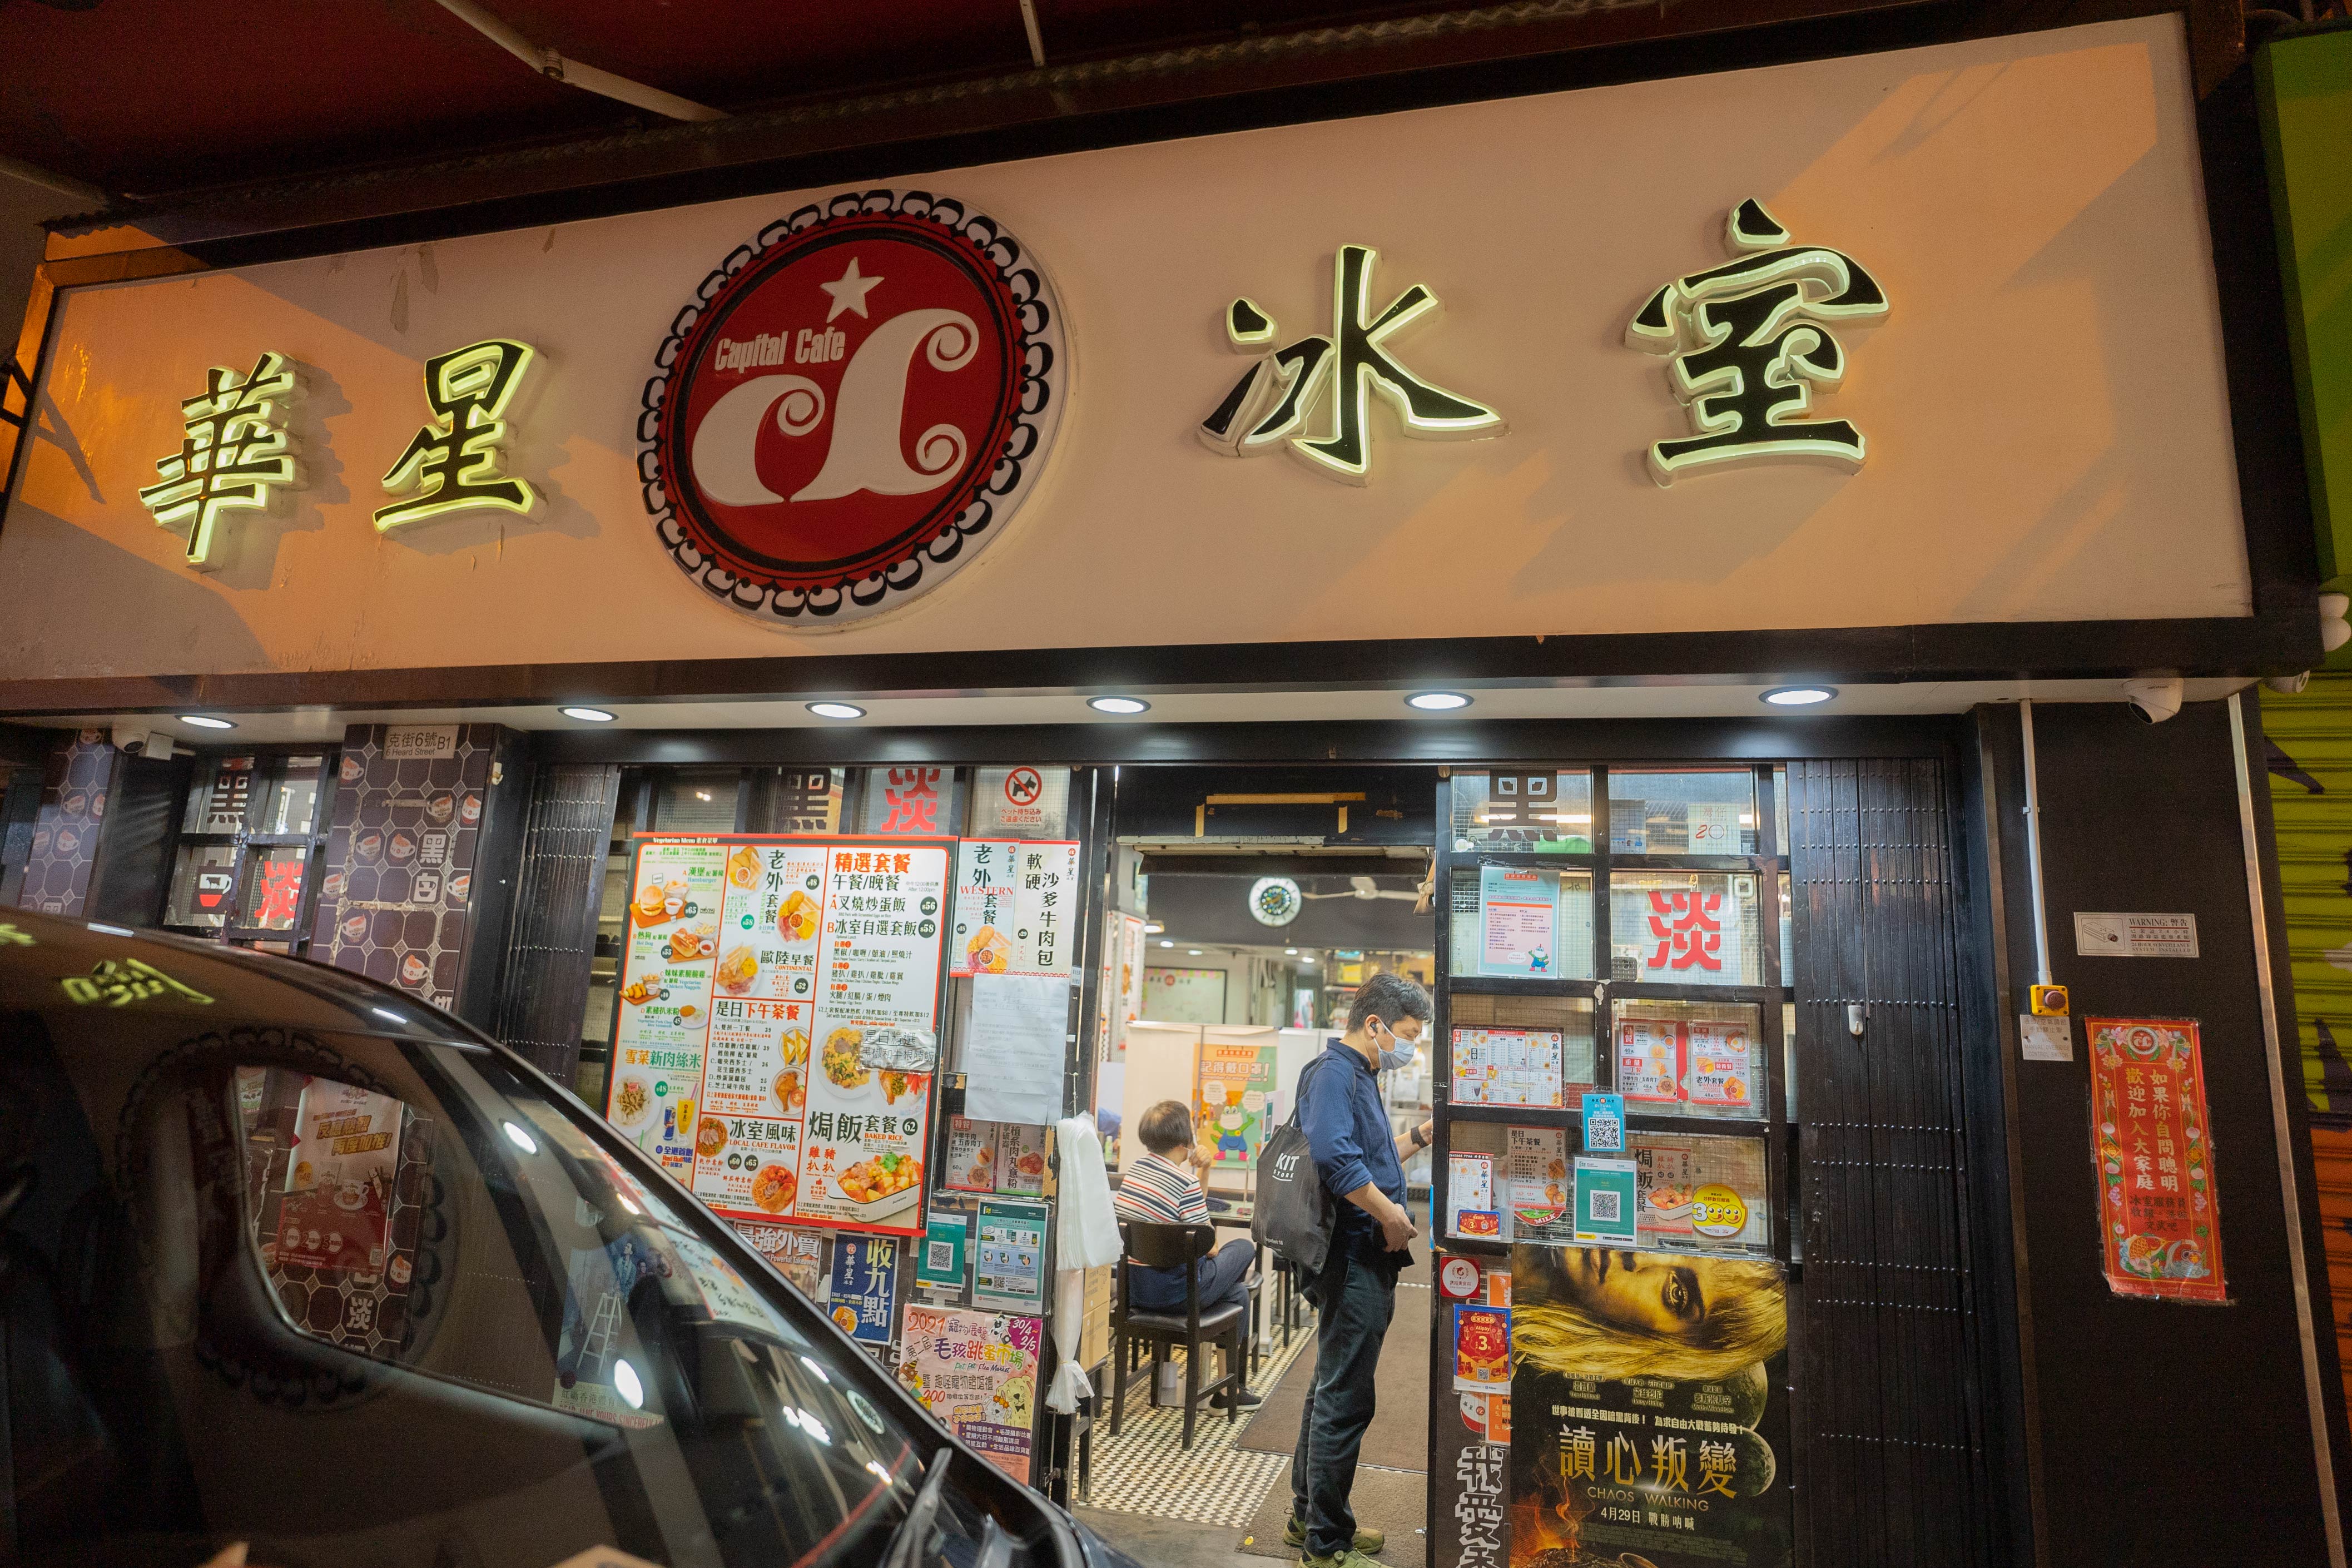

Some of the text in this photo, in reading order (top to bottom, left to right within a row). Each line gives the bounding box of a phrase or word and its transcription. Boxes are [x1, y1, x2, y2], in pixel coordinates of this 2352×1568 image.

[715, 326, 845, 374] Capital Cafe
[387, 732, 450, 750] 克街6號 B1
[1488, 770, 1557, 842] 黑
[835, 852, 910, 874] 精選套餐
[688, 867, 705, 877] 漢堡
[766, 849, 786, 924] 老外套餐
[832, 874, 900, 891] 午餐/晚餐
[960, 886, 1014, 895] WESTERN
[972, 844, 998, 925] 老外套餐
[829, 896, 906, 912] A 叉燒炒蛋飯
[921, 901, 936, 911] $56
[827, 919, 916, 936] B 冰室自選套飯
[920, 924, 934, 933] $58
[2129, 918, 2168, 926] WARNING:
[638, 931, 652, 940] 熱狗
[1647, 891, 1721, 971] 淡
[761, 950, 814, 965] 歐陸早餐
[892, 950, 912, 959] 照燒汁
[851, 970, 864, 979] 雞扒
[847, 992, 861, 1000] 紅腸
[716, 1001, 800, 1021] 是日下午茶餐
[1551, 1043, 1559, 1060] 華星
[1696, 1076, 1724, 1085] 老外套餐
[730, 1119, 796, 1143] 冰室風味
[808, 1111, 897, 1144] 焗飯套餐
[905, 1120, 915, 1132] 62
[2125, 1067, 2156, 1191] 歡迎加入大家庭
[2151, 1069, 2179, 1193] 如果你自問聰明
[1511, 1138, 1541, 1146] 下午茶餐
[822, 1147, 836, 1173] 豬扒
[1276, 1153, 1299, 1171] KIT
[1273, 1169, 1294, 1178] STORE
[1534, 1213, 1557, 1224] MILK
[772, 1255, 817, 1266] Powerful Takeaway
[843, 1255, 856, 1279] 華星
[862, 1239, 894, 1328] 收九點
[907, 1312, 988, 1340] 2021 寵物展覽
[1020, 1336, 1037, 1351] 2/5
[1478, 1336, 1488, 1351] 3
[934, 1337, 1025, 1371] 毛孩跳蚤市場
[955, 1362, 966, 1371] Pet
[977, 1363, 989, 1372] Flea
[990, 1364, 1011, 1373] Market
[924, 1390, 946, 1403] 200
[966, 1425, 993, 1434] 寵物運動會
[1559, 1424, 1737, 1499] 讀心叛變
[1587, 1486, 1709, 1512] CHAOS WALKING
[1601, 1507, 1694, 1531] 4月29日 戰勝吶喊
